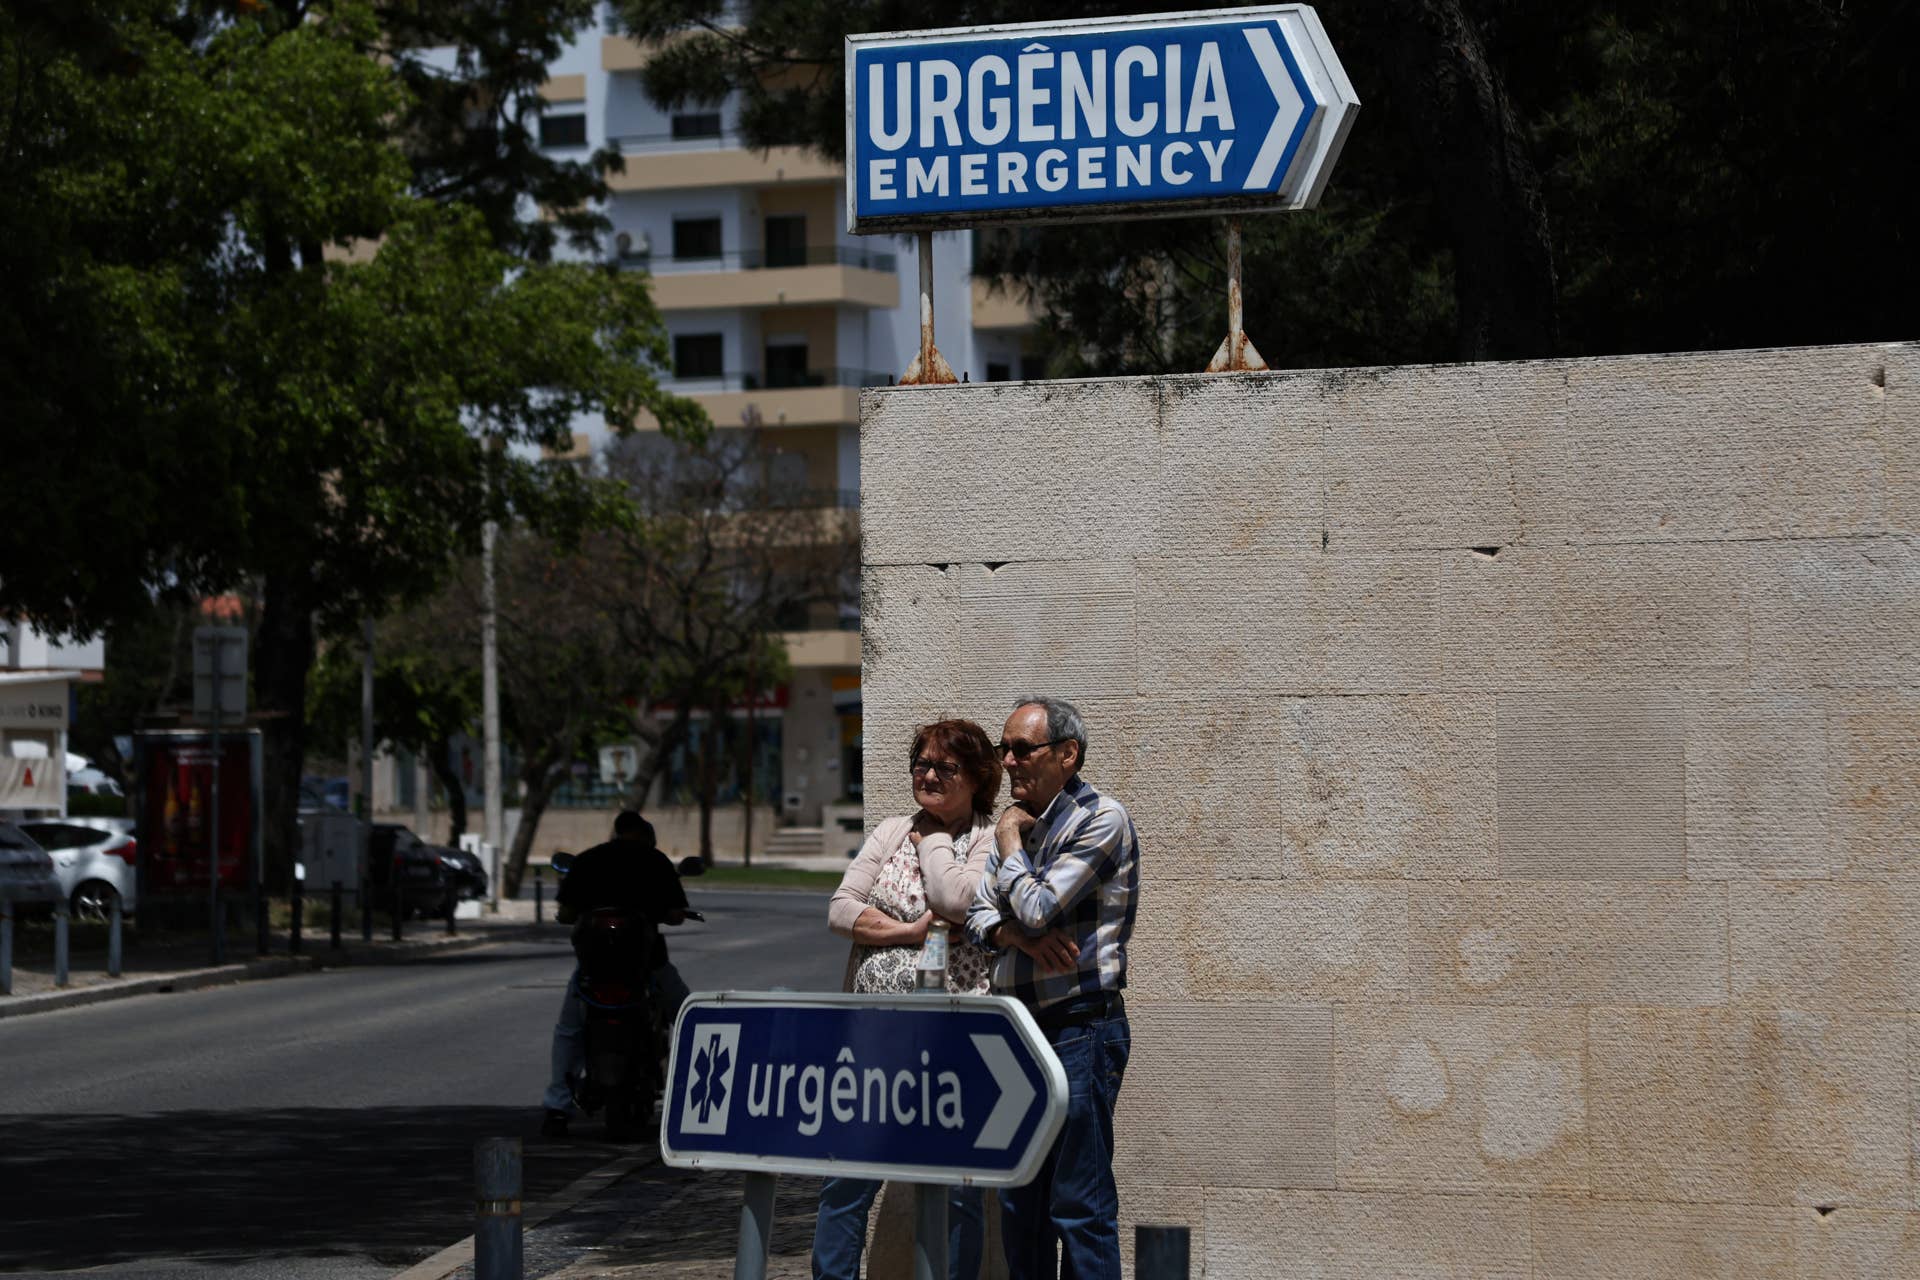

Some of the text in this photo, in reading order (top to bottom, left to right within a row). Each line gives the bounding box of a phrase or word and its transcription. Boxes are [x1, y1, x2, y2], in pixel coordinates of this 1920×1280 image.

[869, 42, 1235, 151] URGÊNCIA
[869, 139, 1234, 200] EMERGENCY
[746, 1047, 964, 1136] urgência
